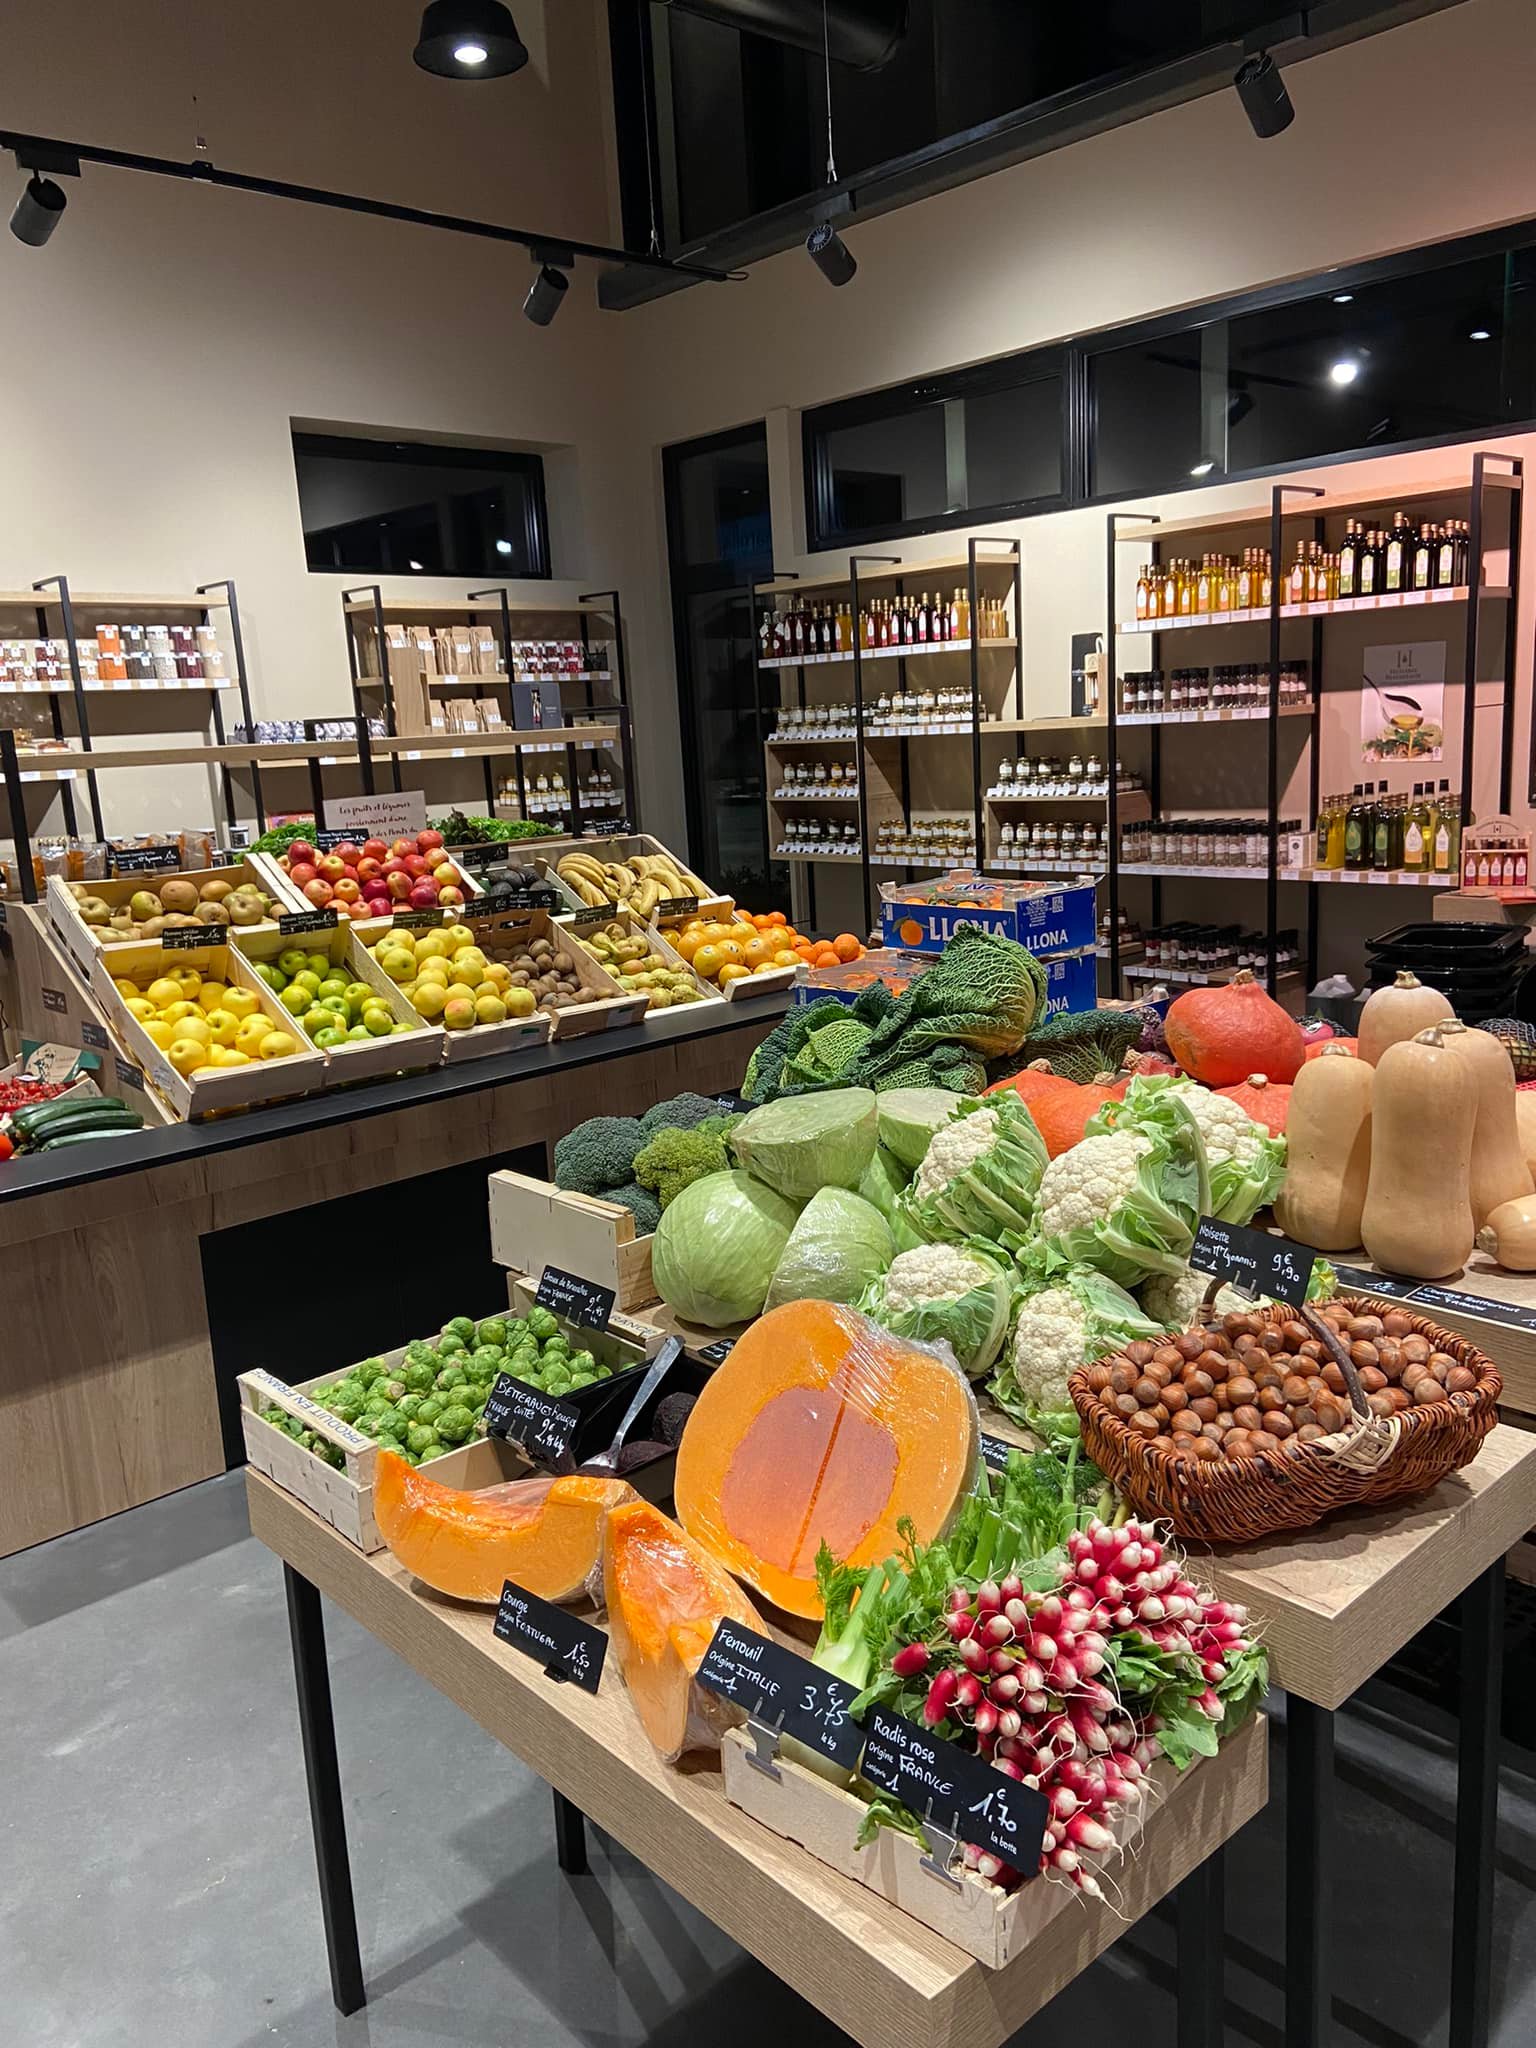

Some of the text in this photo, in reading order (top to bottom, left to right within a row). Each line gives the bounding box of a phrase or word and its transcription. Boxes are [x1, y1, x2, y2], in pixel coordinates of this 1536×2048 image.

[352, 804, 372, 816] fruits
[1026, 929, 1069, 950] LLONA
[1199, 1225, 1230, 1244] Noisette
[249, 1370, 361, 1444] PRODUIT EN FRANCE
[503, 1589, 529, 1615] Courge
[718, 1629, 764, 1662] Fenouil
[708, 1650, 735, 1670] Origine
[827, 1683, 839, 1696] €
[873, 1715, 936, 1764] Radis rose
[868, 1741, 894, 1764] Origine
[996, 1788, 1006, 1800] €
[886, 1773, 899, 1791] 1
[968, 1792, 1017, 1833] 1,70
[990, 1830, 999, 1844] la
